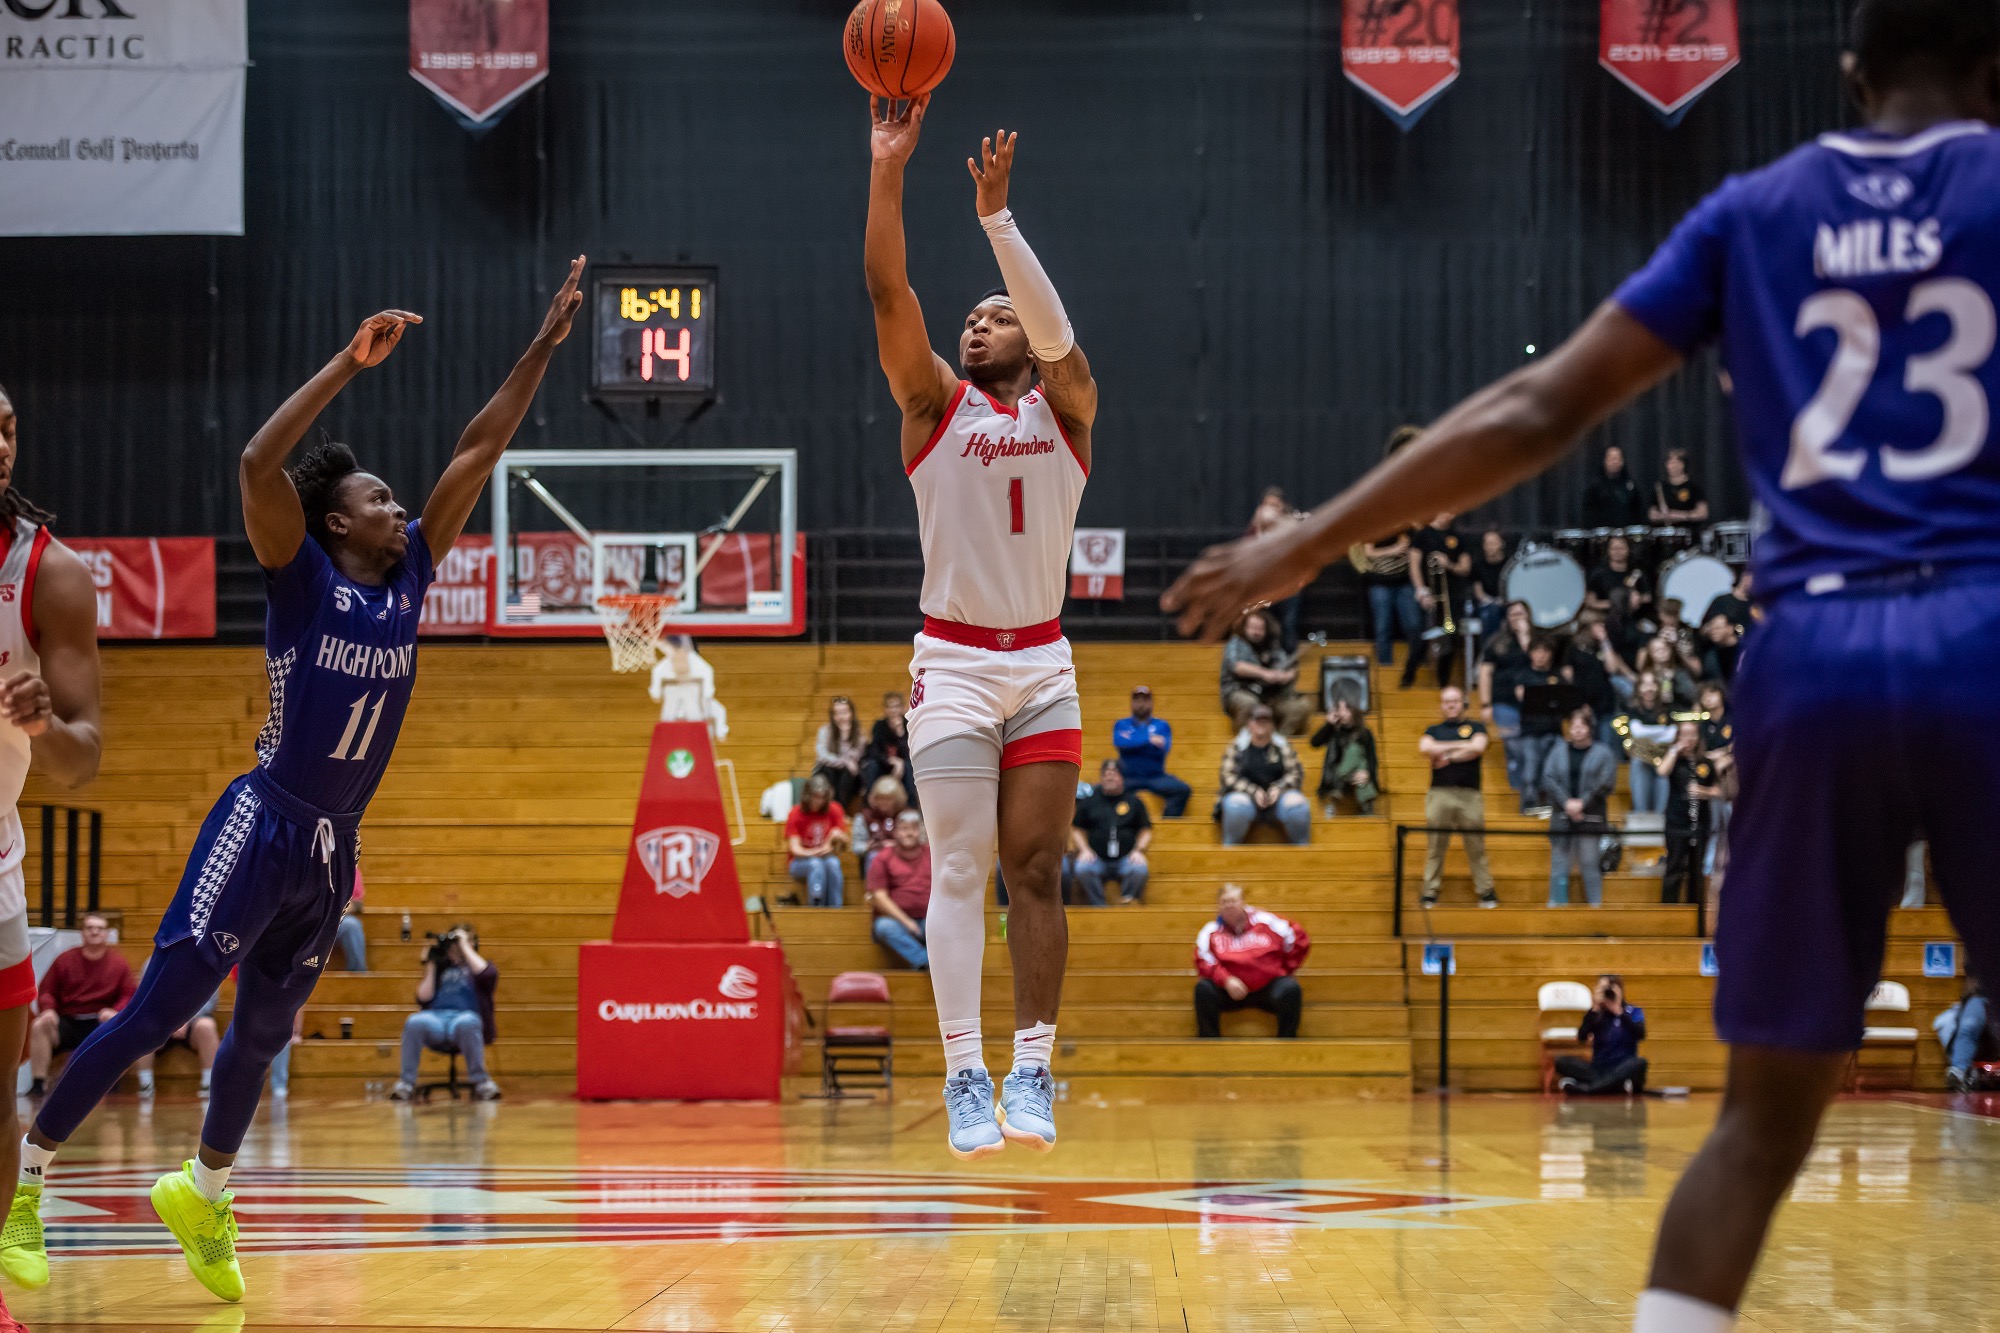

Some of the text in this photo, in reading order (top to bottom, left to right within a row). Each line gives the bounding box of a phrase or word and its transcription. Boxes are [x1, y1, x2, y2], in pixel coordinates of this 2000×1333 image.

[5, 34, 145, 60] RACTIC
[1607, 43, 1729, 62] 2011-2015
[1813, 215, 1943, 278] MILES
[620, 287, 701, 322] 16:41
[641, 327, 691, 382] 14
[1779, 276, 1998, 491] 23
[960, 432, 1055, 467] Highlanders
[1006, 476, 1026, 536] 1
[315, 634, 414, 679] HIGH POINT
[327, 690, 388, 761] 11
